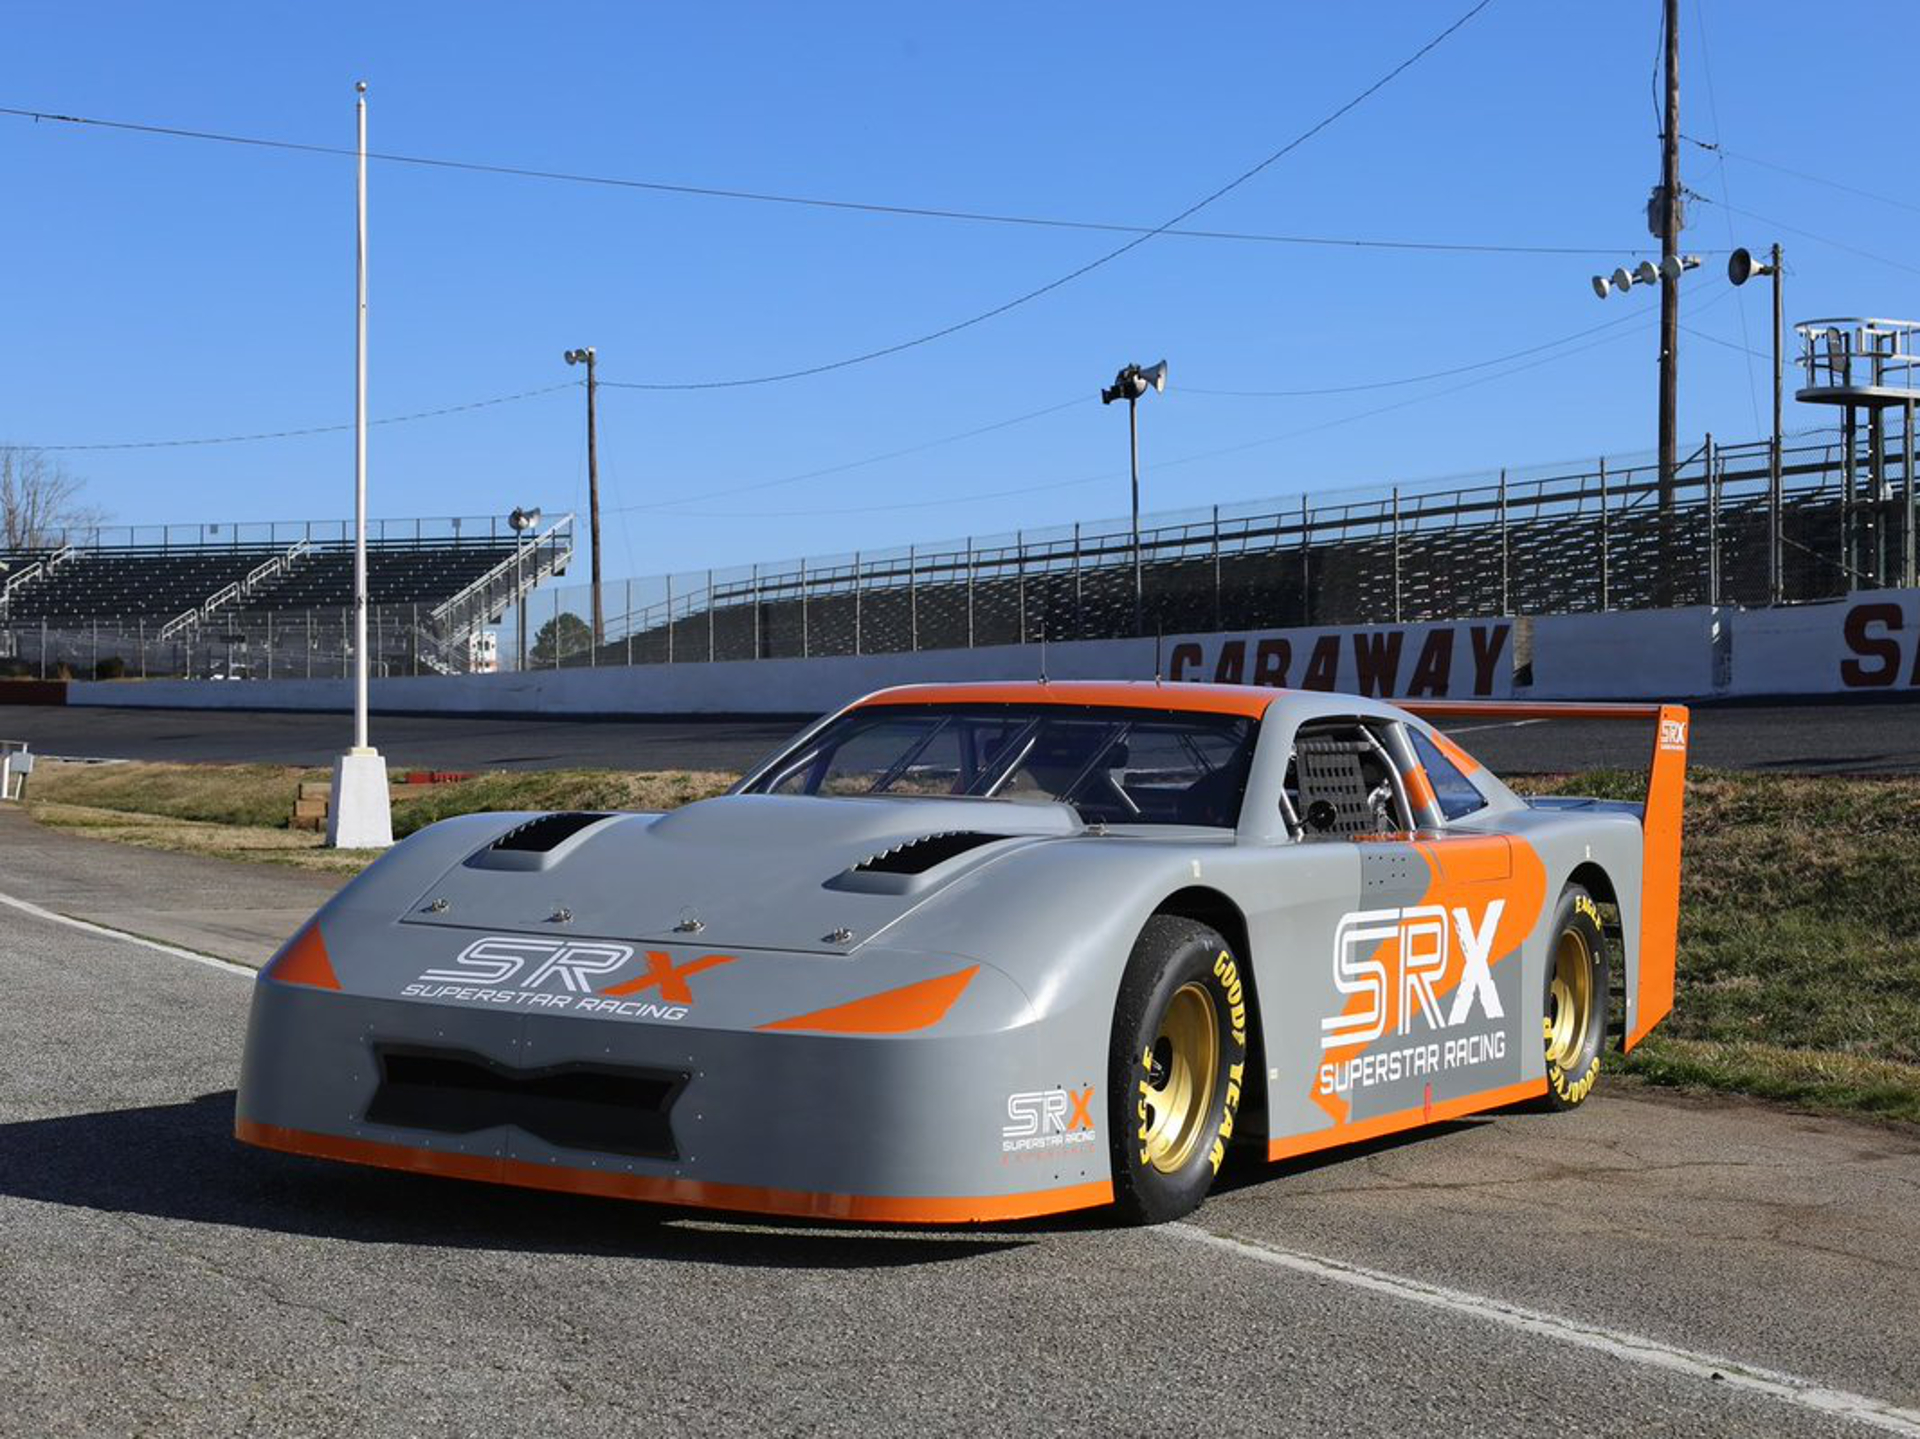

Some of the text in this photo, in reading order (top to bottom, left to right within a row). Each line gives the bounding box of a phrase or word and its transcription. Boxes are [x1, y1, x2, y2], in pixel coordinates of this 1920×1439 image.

[1169, 624, 1510, 698] CARAWAY
[1841, 603, 1920, 688] S
[1660, 720, 1687, 744] SRX
[400, 984, 690, 1021] SUPERSTAR RACING
[417, 936, 741, 1006] SRX
[1320, 898, 1507, 1050] SRX
[1319, 1030, 1507, 1096] SUPERSTAR RACING
[1002, 1084, 1096, 1138] SRX
[1002, 1134, 1064, 1152] SUPERSTAR
